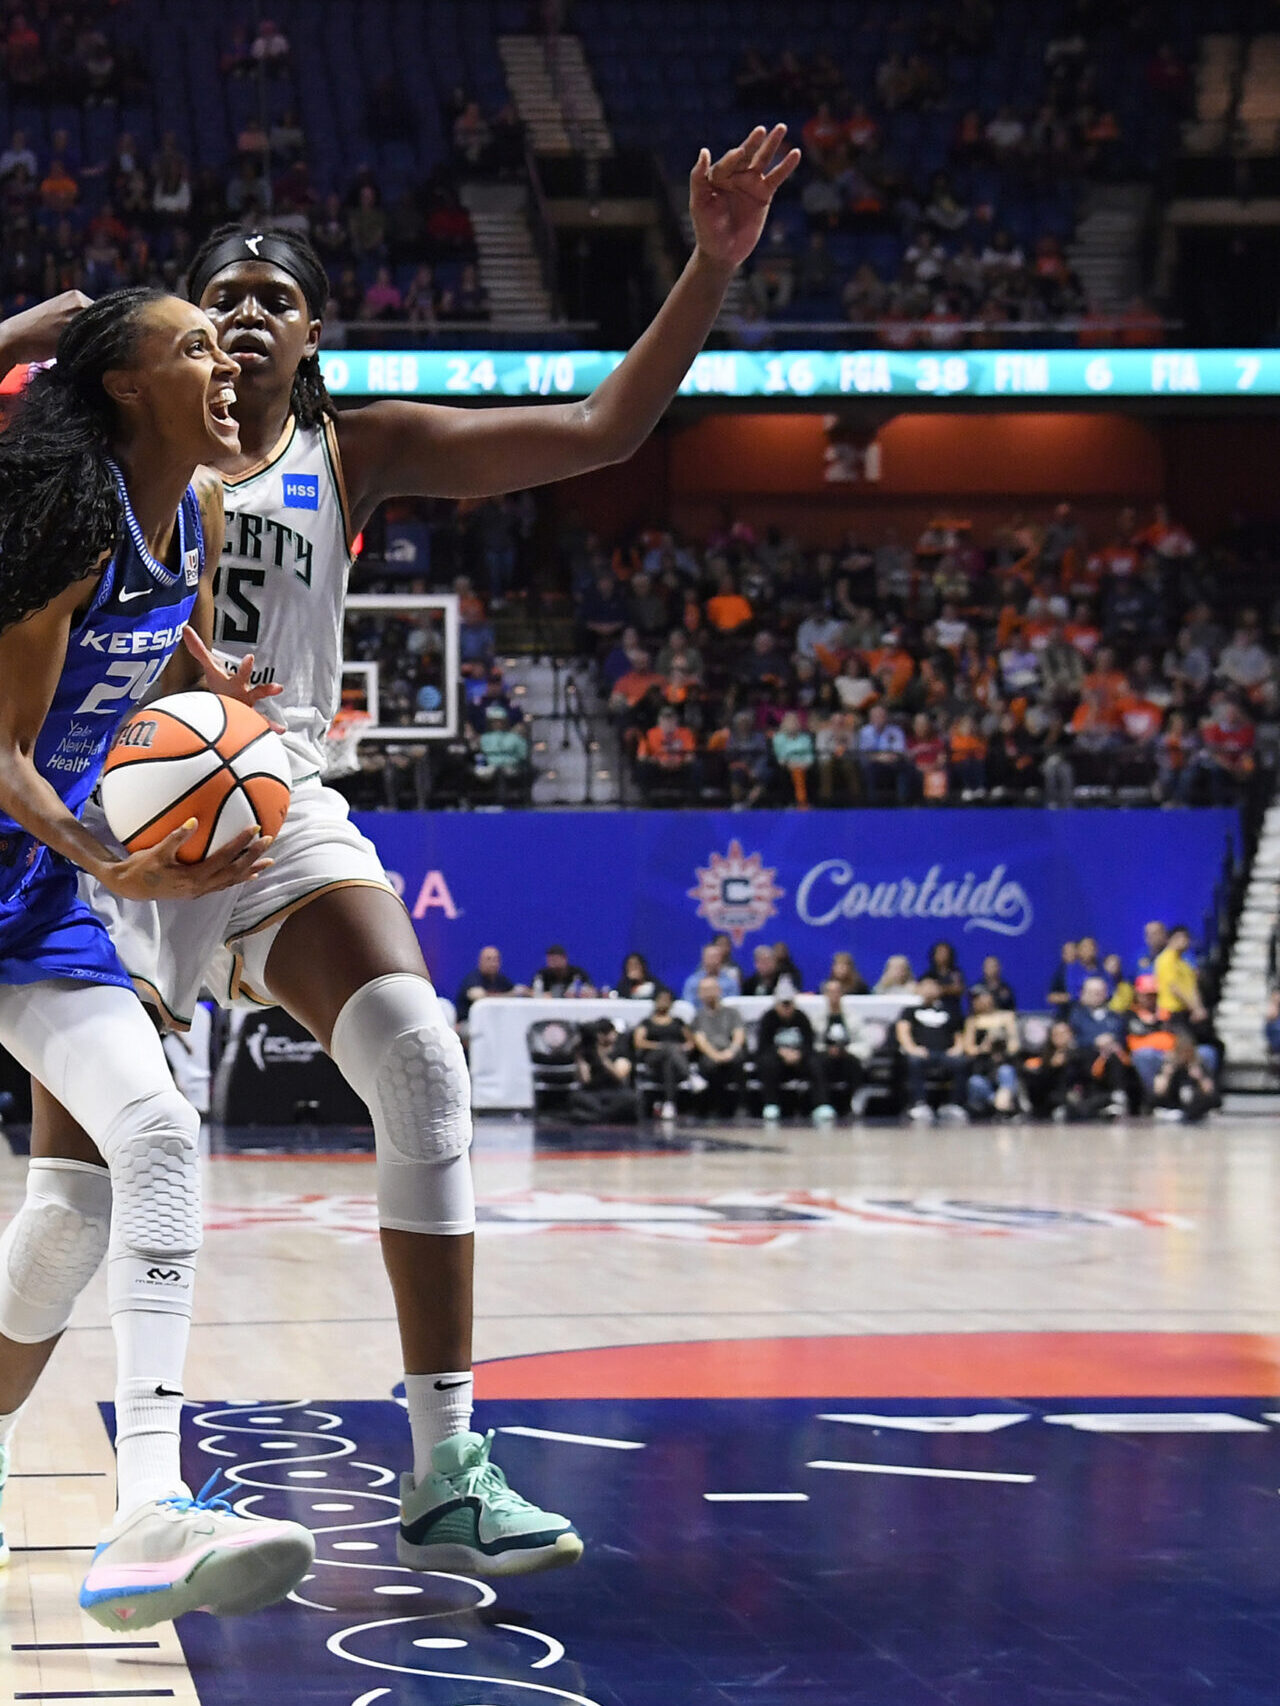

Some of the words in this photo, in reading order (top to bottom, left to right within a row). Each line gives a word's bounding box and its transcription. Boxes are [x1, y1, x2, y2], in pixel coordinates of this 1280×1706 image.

[324, 358, 350, 391] 0
[367, 356, 418, 390] REB
[445, 359, 497, 390] 24
[526, 358, 575, 394] T/O
[764, 357, 815, 392] 16
[840, 355, 892, 392] FGA
[916, 358, 969, 392] 38
[995, 355, 1050, 392] FTM
[1085, 358, 1114, 391] 6
[1151, 354, 1201, 391] FTA
[1235, 357, 1261, 391] 7
[286, 484, 316, 497] HSS
[222, 510, 313, 590] ERTY
[796, 858, 1034, 936] Courtside
